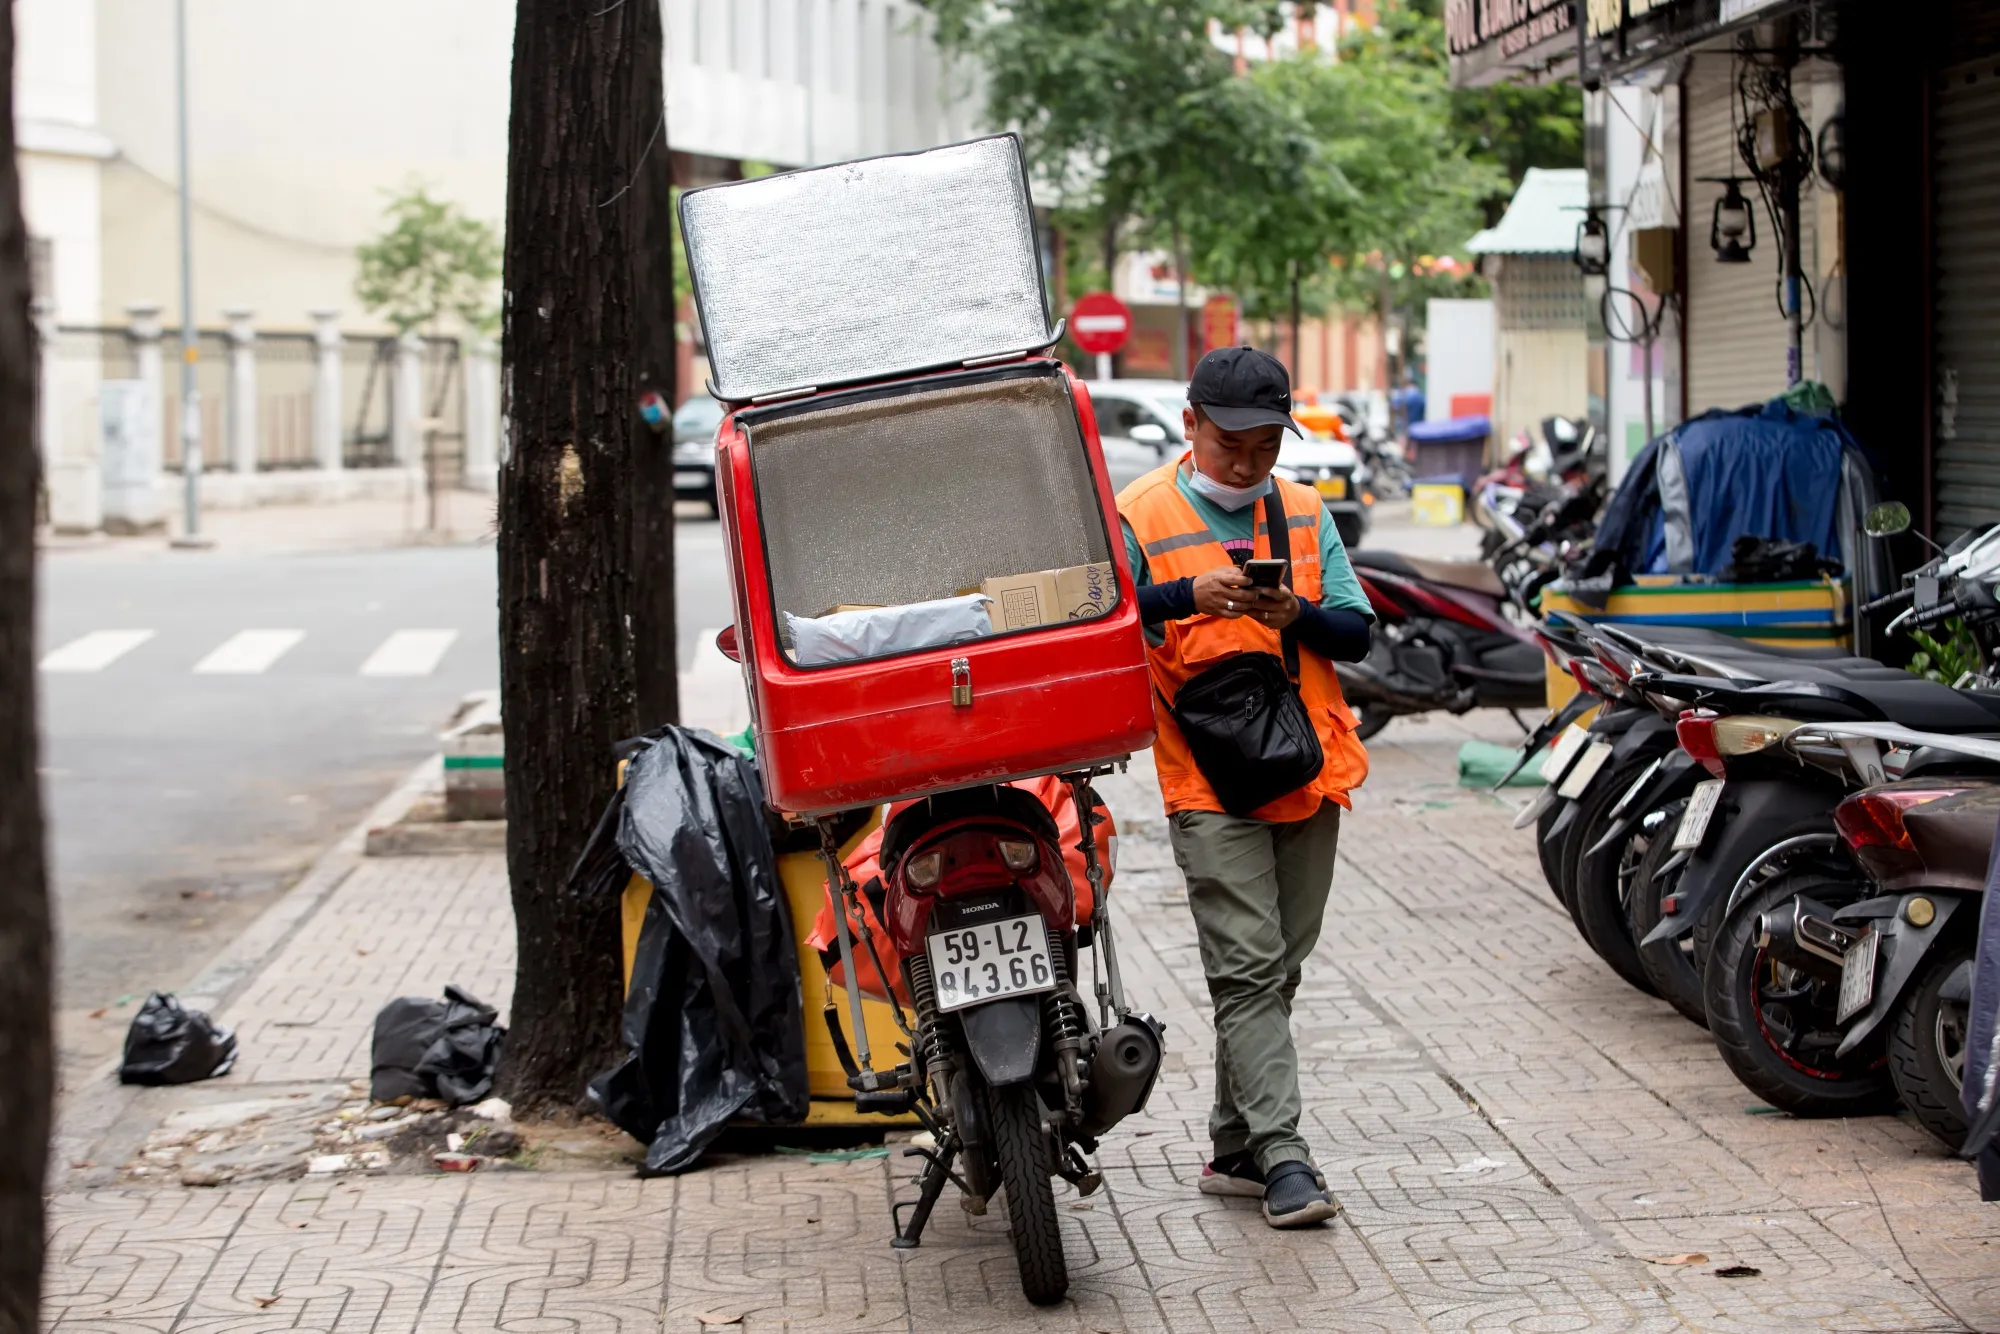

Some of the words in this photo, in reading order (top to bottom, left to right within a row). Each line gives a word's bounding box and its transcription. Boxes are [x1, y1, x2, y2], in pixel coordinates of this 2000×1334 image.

[962, 902, 1000, 915] HONDA
[944, 920, 1032, 965] 59-L2
[940, 953, 1049, 1004] 843.66
